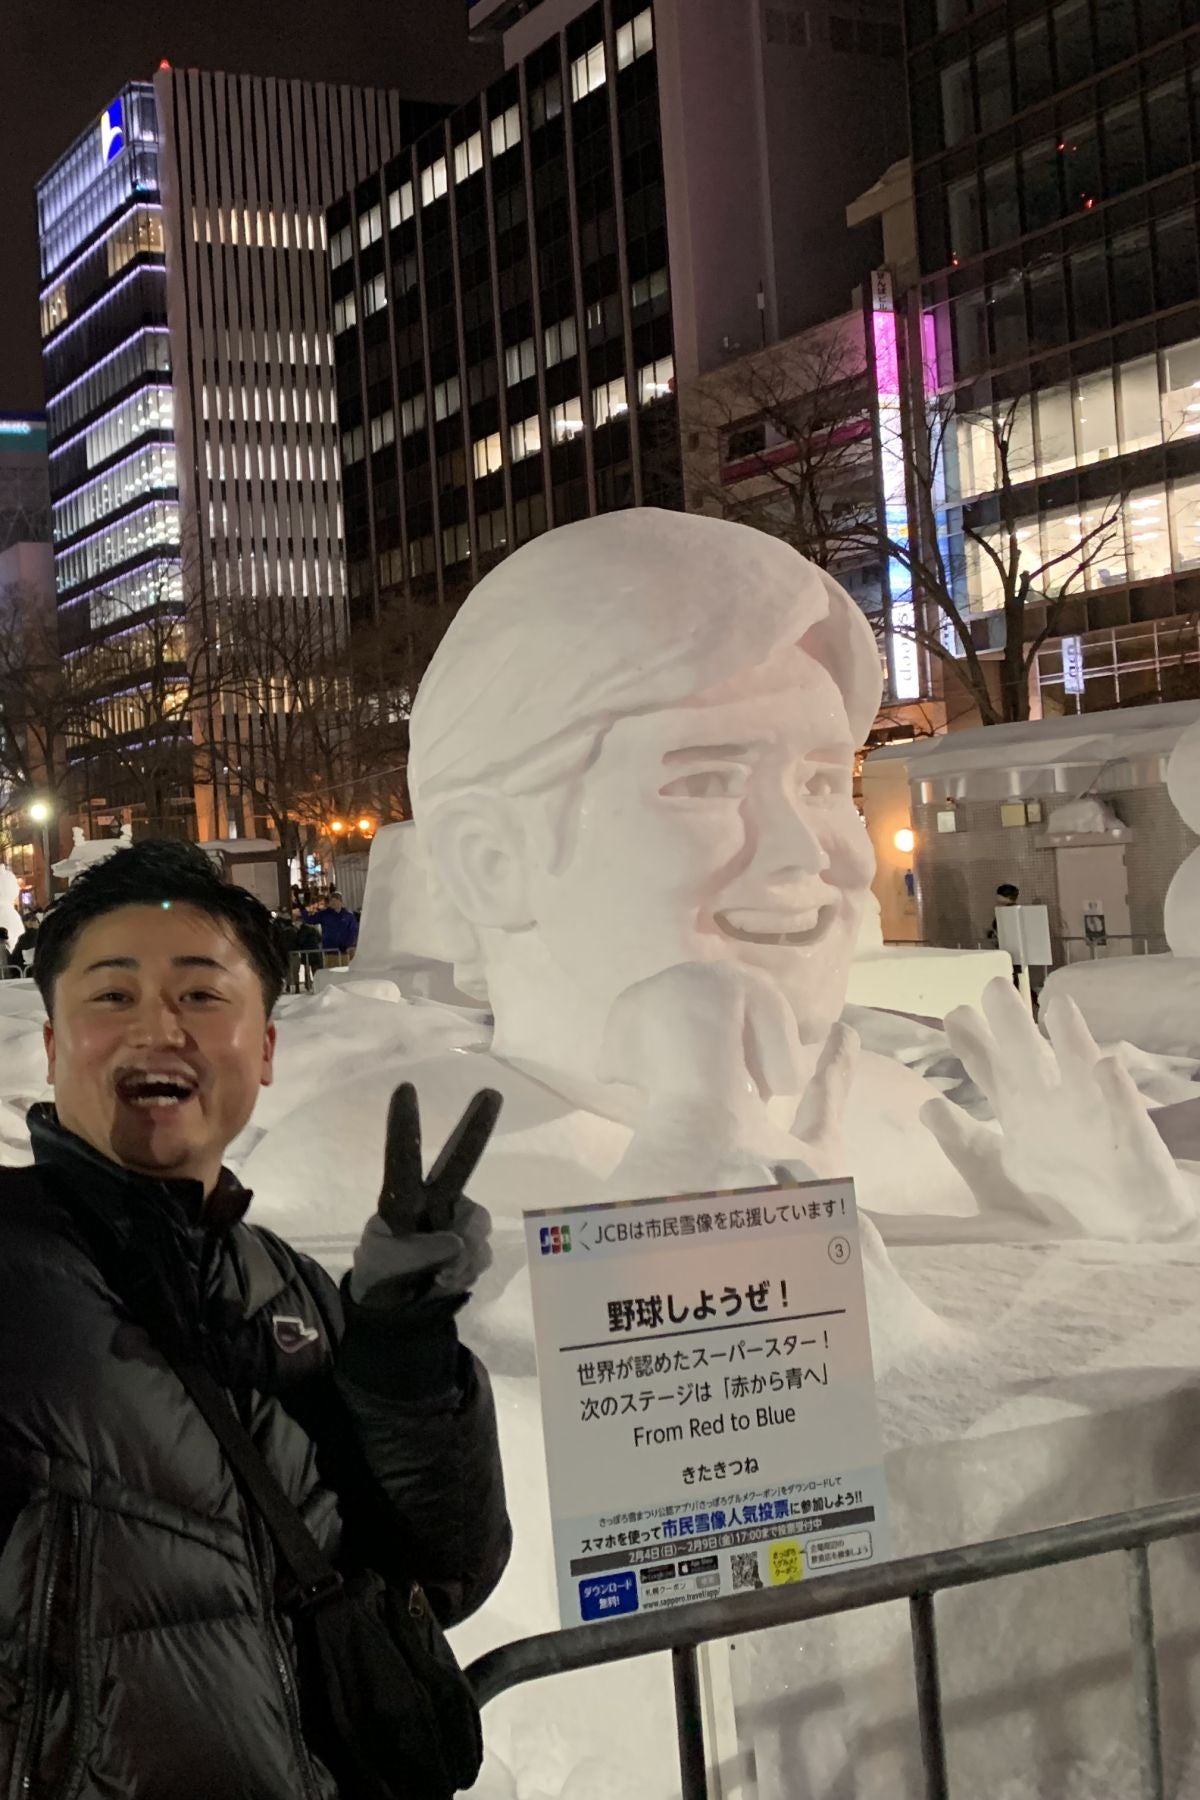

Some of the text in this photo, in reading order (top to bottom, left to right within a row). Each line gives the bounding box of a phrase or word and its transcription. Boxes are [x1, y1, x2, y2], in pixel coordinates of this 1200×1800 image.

[608, 1280, 788, 1332] 野球しようぜ！
[577, 1330, 829, 1387] 世界が認めたスーパースター！
[580, 1363, 828, 1421] 次のステージは「赤から青へ」
[634, 1405, 796, 1447] From Red to Blue
[682, 1457, 759, 1484] きたきつね
[584, 1579, 632, 1599] ダウンロード
